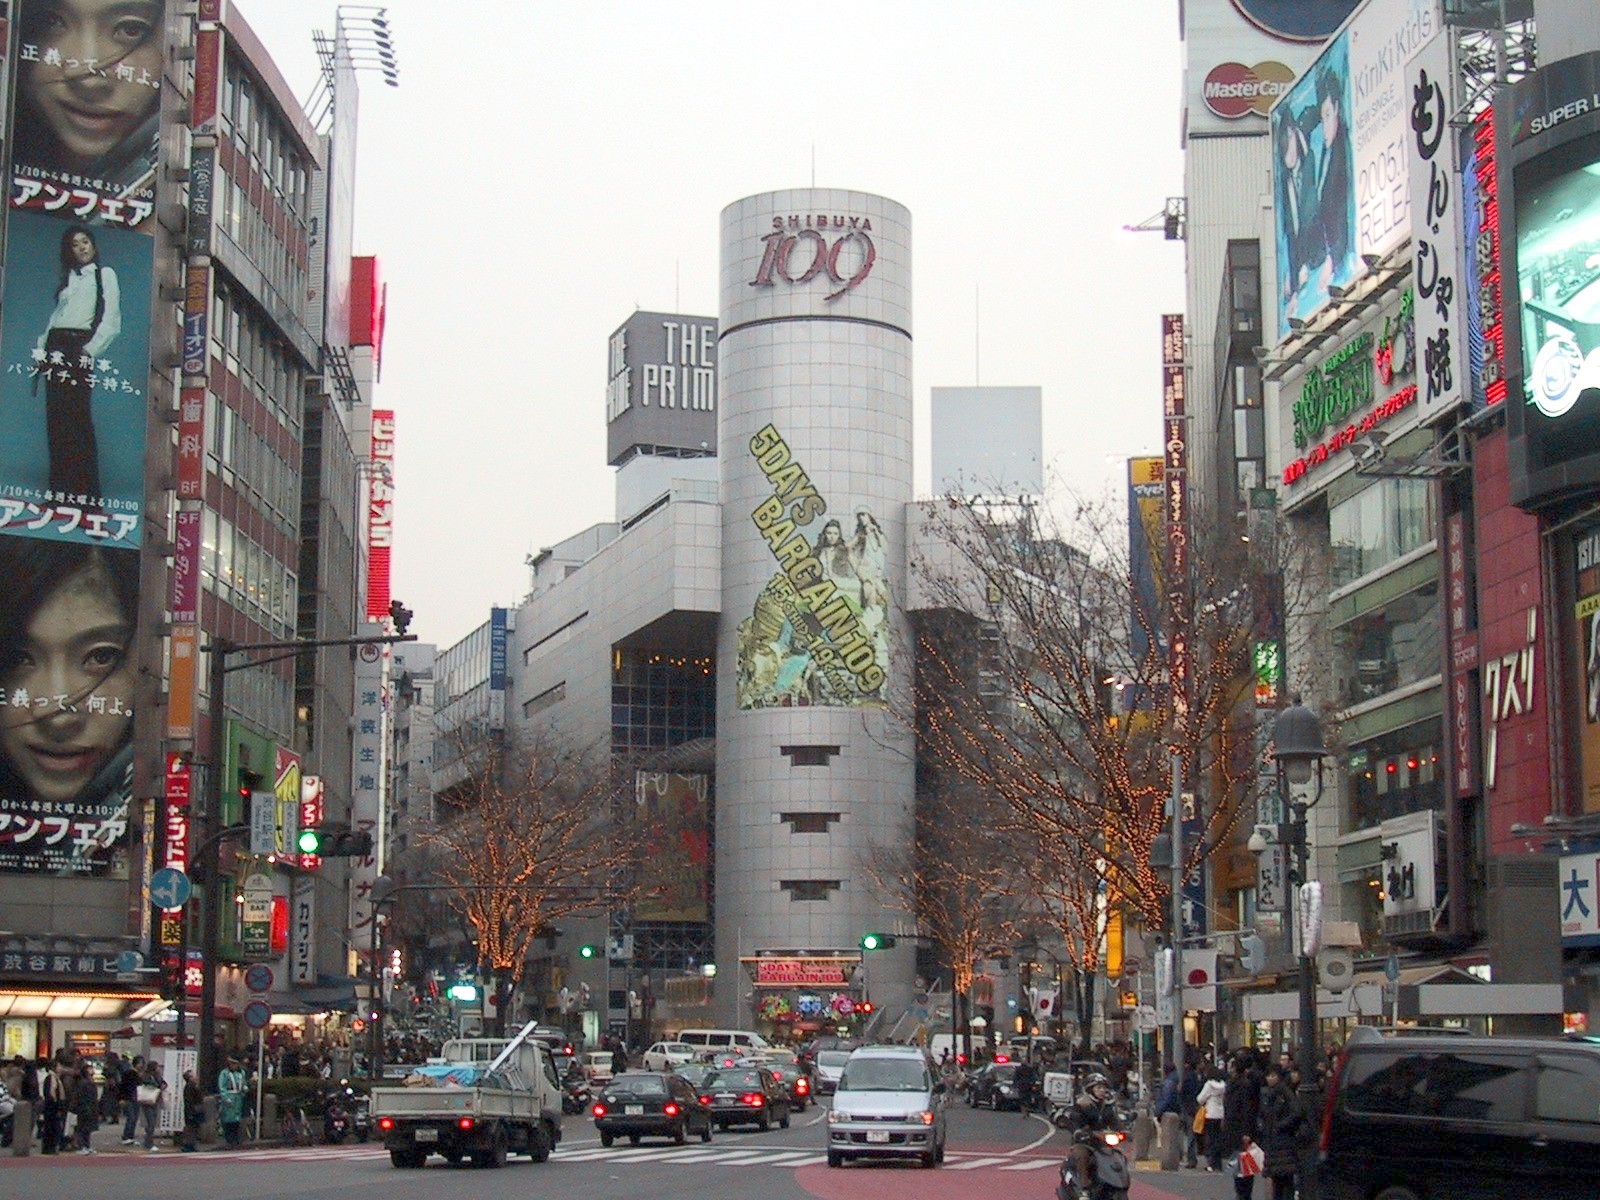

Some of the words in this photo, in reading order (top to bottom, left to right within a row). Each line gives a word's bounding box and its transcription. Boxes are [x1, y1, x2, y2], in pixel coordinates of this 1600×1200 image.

[20, 43, 160, 89] 正義って、何よ。
[1354, 39, 1394, 107] KinKi
[1395, 10, 1432, 57] Kids
[1530, 98, 1589, 134] SUPER
[12, 177, 154, 227] アンフェア
[14, 163, 154, 199] 1/10から毎週火曜よる1:00
[772, 213, 873, 231] SHIBUYA
[1361, 183, 1410, 253] RELE
[1411, 68, 1452, 404] もんじゃ焼
[748, 229, 877, 301] 109
[662, 321, 714, 367] THE
[7, 361, 141, 396] バツイチ。子持ち。
[180, 481, 199, 493] 6F
[749, 423, 828, 527] 5DAYS
[178, 512, 200, 524] 5F
[751, 494, 860, 643] BARGAIN
[836, 632, 886, 694] 109
[1563, 868, 1590, 920] 大
